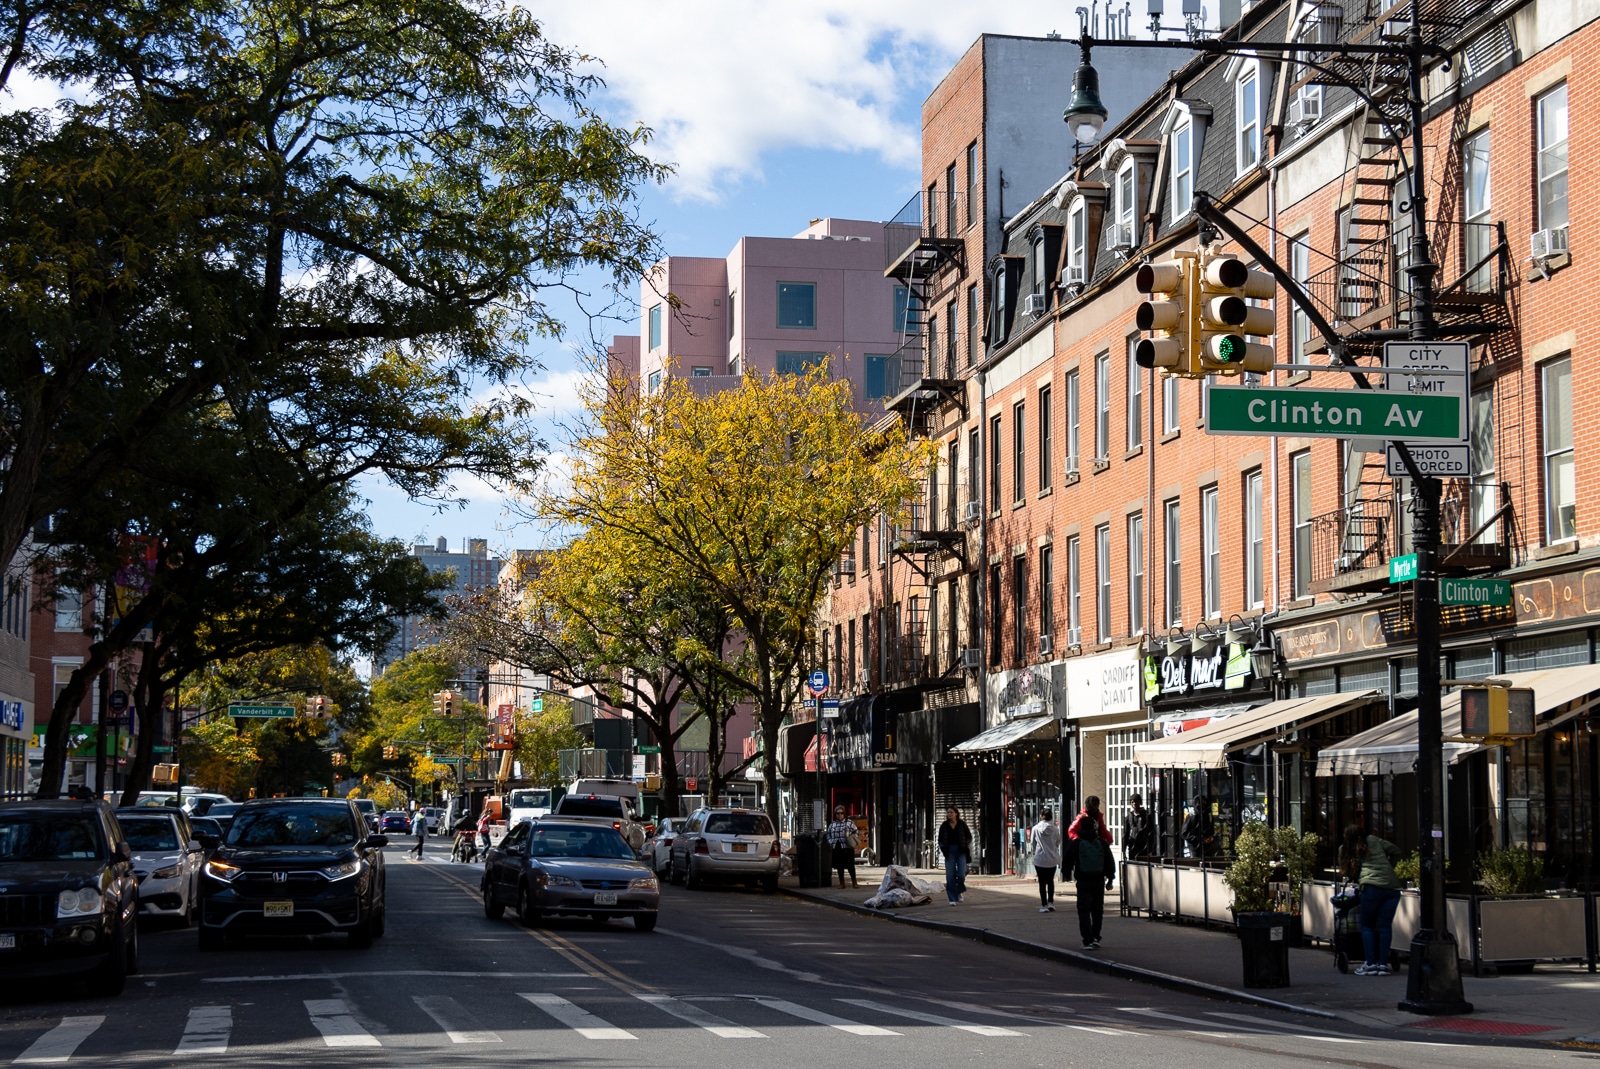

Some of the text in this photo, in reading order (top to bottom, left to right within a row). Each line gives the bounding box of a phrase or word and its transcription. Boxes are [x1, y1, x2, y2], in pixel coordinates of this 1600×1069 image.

[1409, 349, 1442, 361] CITY
[1408, 380, 1445, 392] LMIT
[1247, 398, 1424, 428] Clinton Av
[1395, 461, 1463, 472] EORCED
[1393, 561, 1411, 582] Myrtle
[1445, 582, 1504, 602] Clinton Av
[1102, 664, 1136, 685] CARDIFF
[1161, 656, 1188, 694] Deli
[1103, 686, 1134, 707] GIANT
